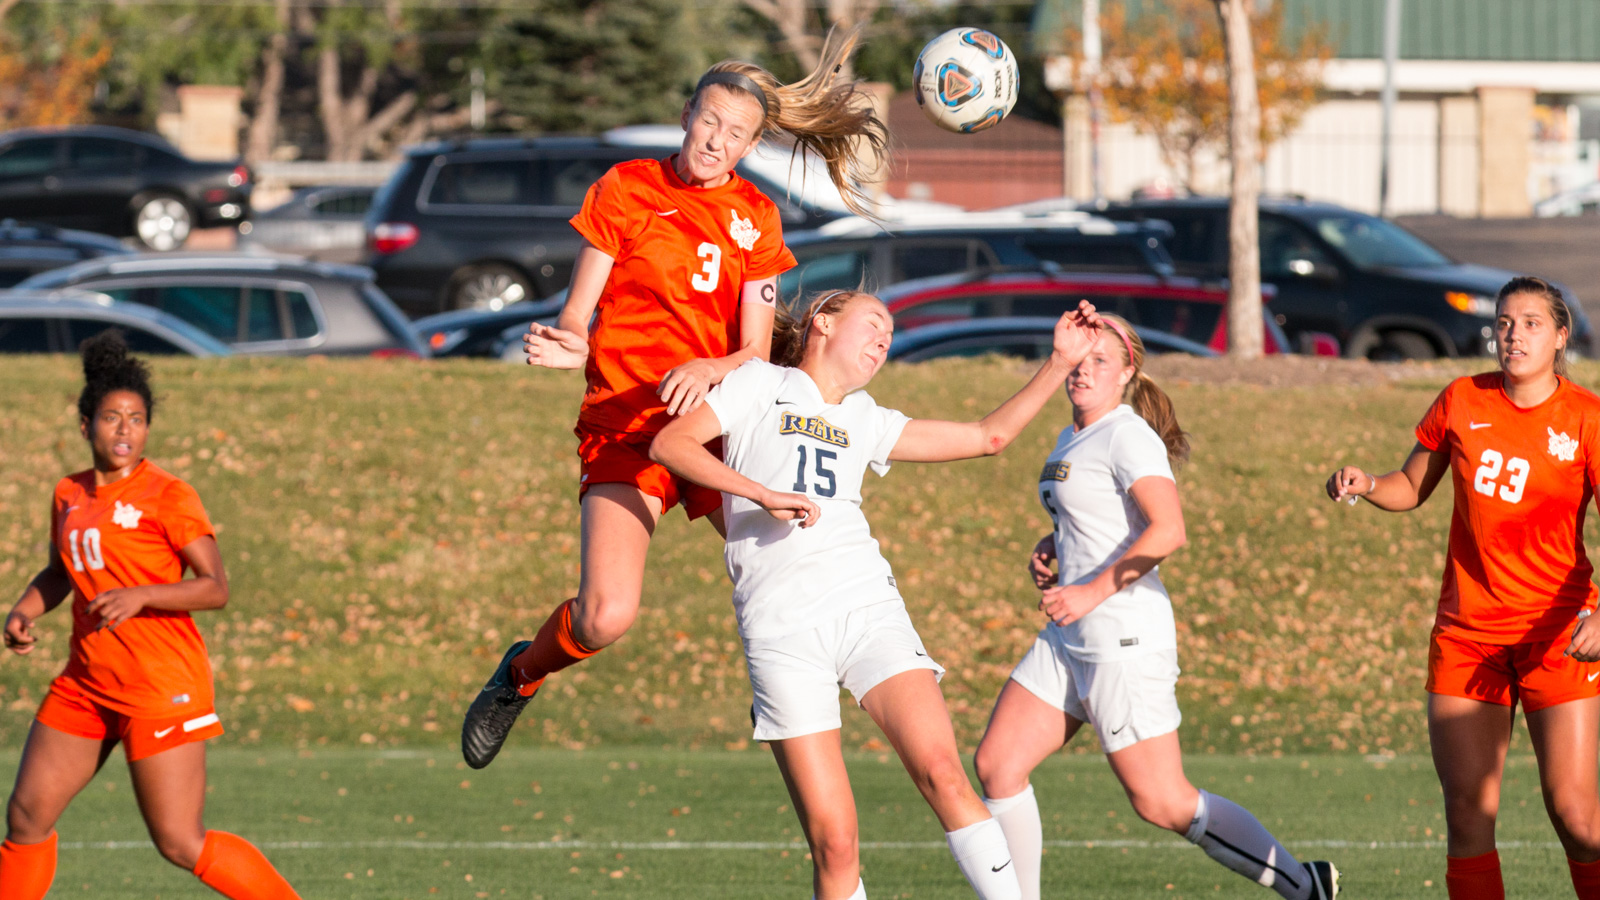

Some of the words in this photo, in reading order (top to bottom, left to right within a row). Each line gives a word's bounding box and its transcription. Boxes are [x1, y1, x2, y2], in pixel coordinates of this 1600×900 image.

[691, 242, 721, 293] 3
[760, 283, 775, 304] C
[780, 411, 850, 448] REGIS
[792, 444, 838, 498] 15
[1474, 448, 1530, 504] 23
[69, 528, 105, 572] 10
